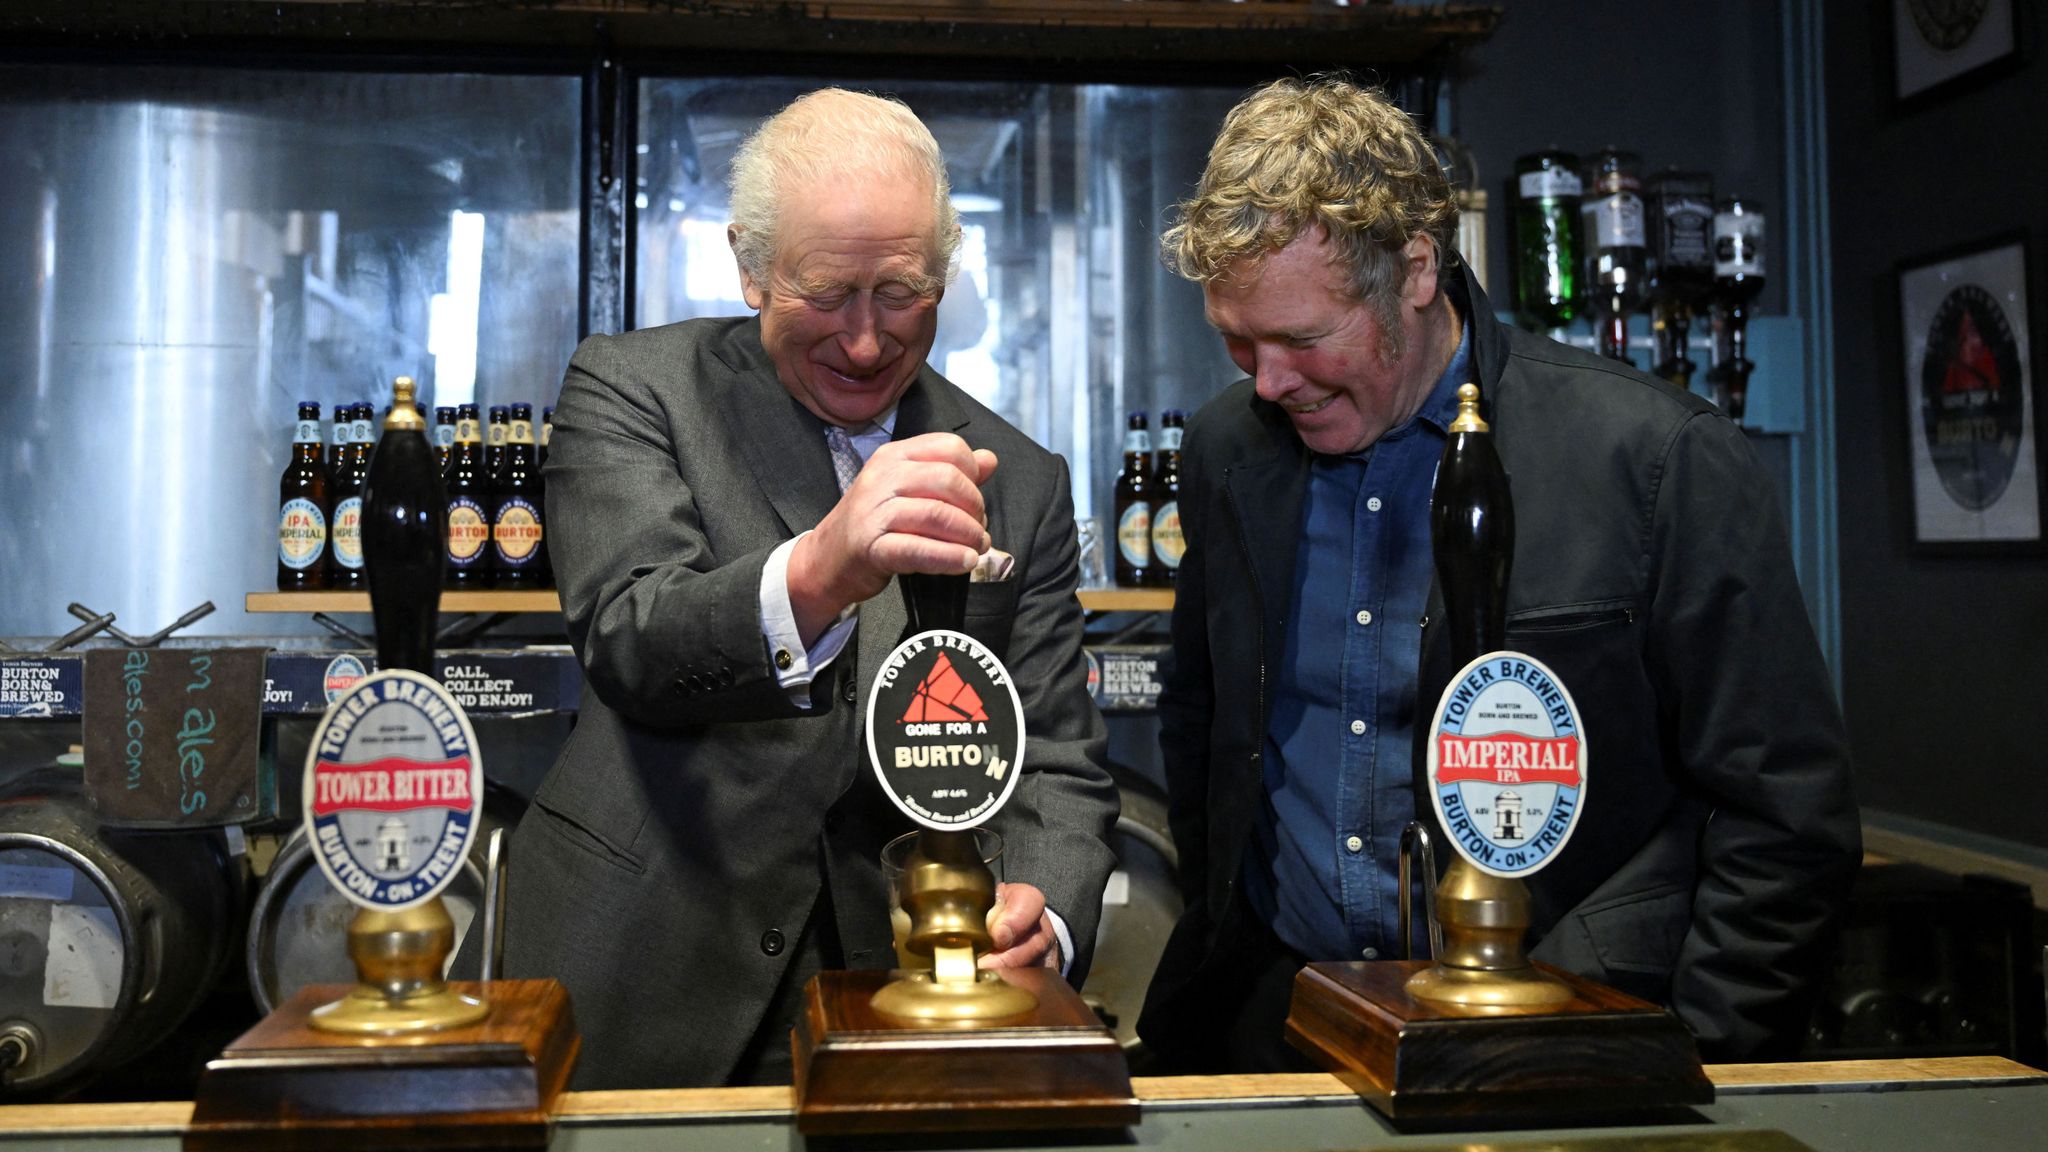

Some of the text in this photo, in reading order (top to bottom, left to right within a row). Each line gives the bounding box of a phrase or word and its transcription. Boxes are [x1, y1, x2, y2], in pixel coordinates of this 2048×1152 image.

[288, 515, 310, 527] IPA
[449, 527, 487, 538] URTON
[496, 527, 541, 538] BURTON
[880, 635, 1006, 689] TOWER BREWERY
[1103, 660, 1157, 672] BURTON
[2, 668, 60, 680] BURTON
[445, 680, 514, 692] COLLECT
[1, 691, 64, 702] BREWED
[263, 690, 292, 702] JOY!
[455, 694, 533, 706] ND ENJOY!
[1444, 660, 1573, 730] TOWER BREWERY
[321, 679, 468, 755] TOWER BREWERY
[905, 722, 987, 737] GONE FOR A
[1443, 739, 1574, 770] IMPERIAL
[1497, 770, 1521, 782] IPA
[318, 768, 469, 804] TOWER BITTER
[1442, 793, 1493, 863] BURTON
[1505, 851, 1527, 867] ON
[1533, 796, 1573, 855] TRENT
[318, 824, 379, 899] BURTON
[387, 881, 414, 902] ON
[418, 820, 467, 887] TRENT
